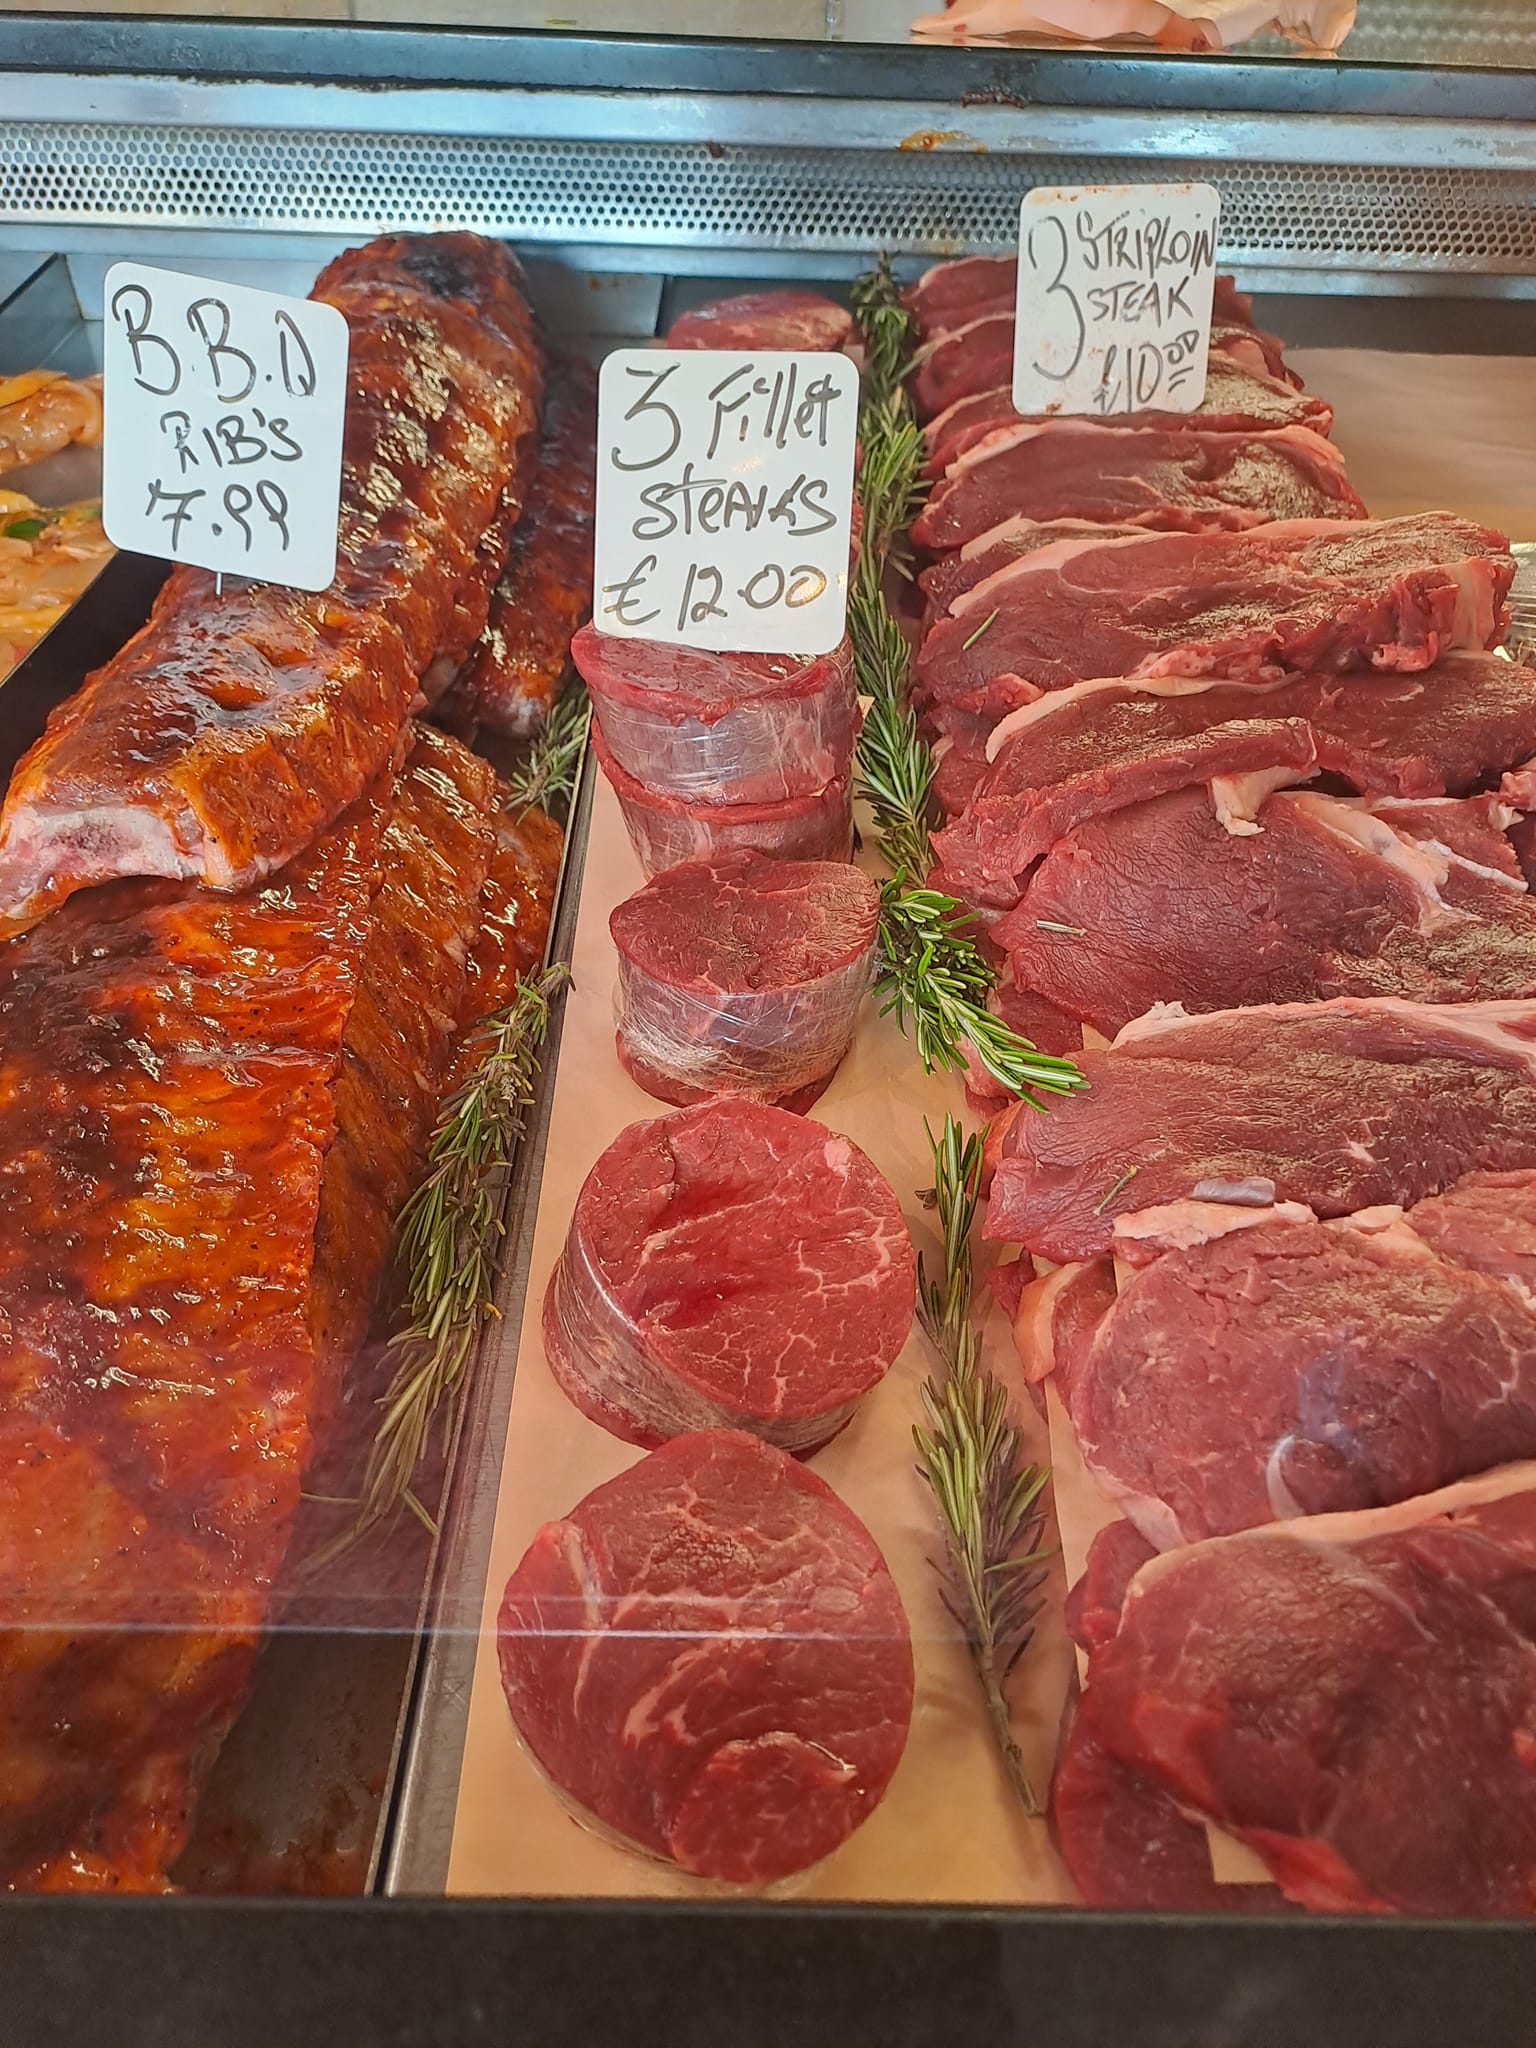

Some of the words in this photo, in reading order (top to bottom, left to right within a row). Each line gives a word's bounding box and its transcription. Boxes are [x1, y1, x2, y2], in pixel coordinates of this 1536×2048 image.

[1028, 214, 1085, 381] 3
[1076, 208, 1217, 280] STRIPLOIN
[1087, 275, 1194, 329] STEAK
[160, 408, 303, 474] RIB'S
[611, 361, 682, 472] 3
